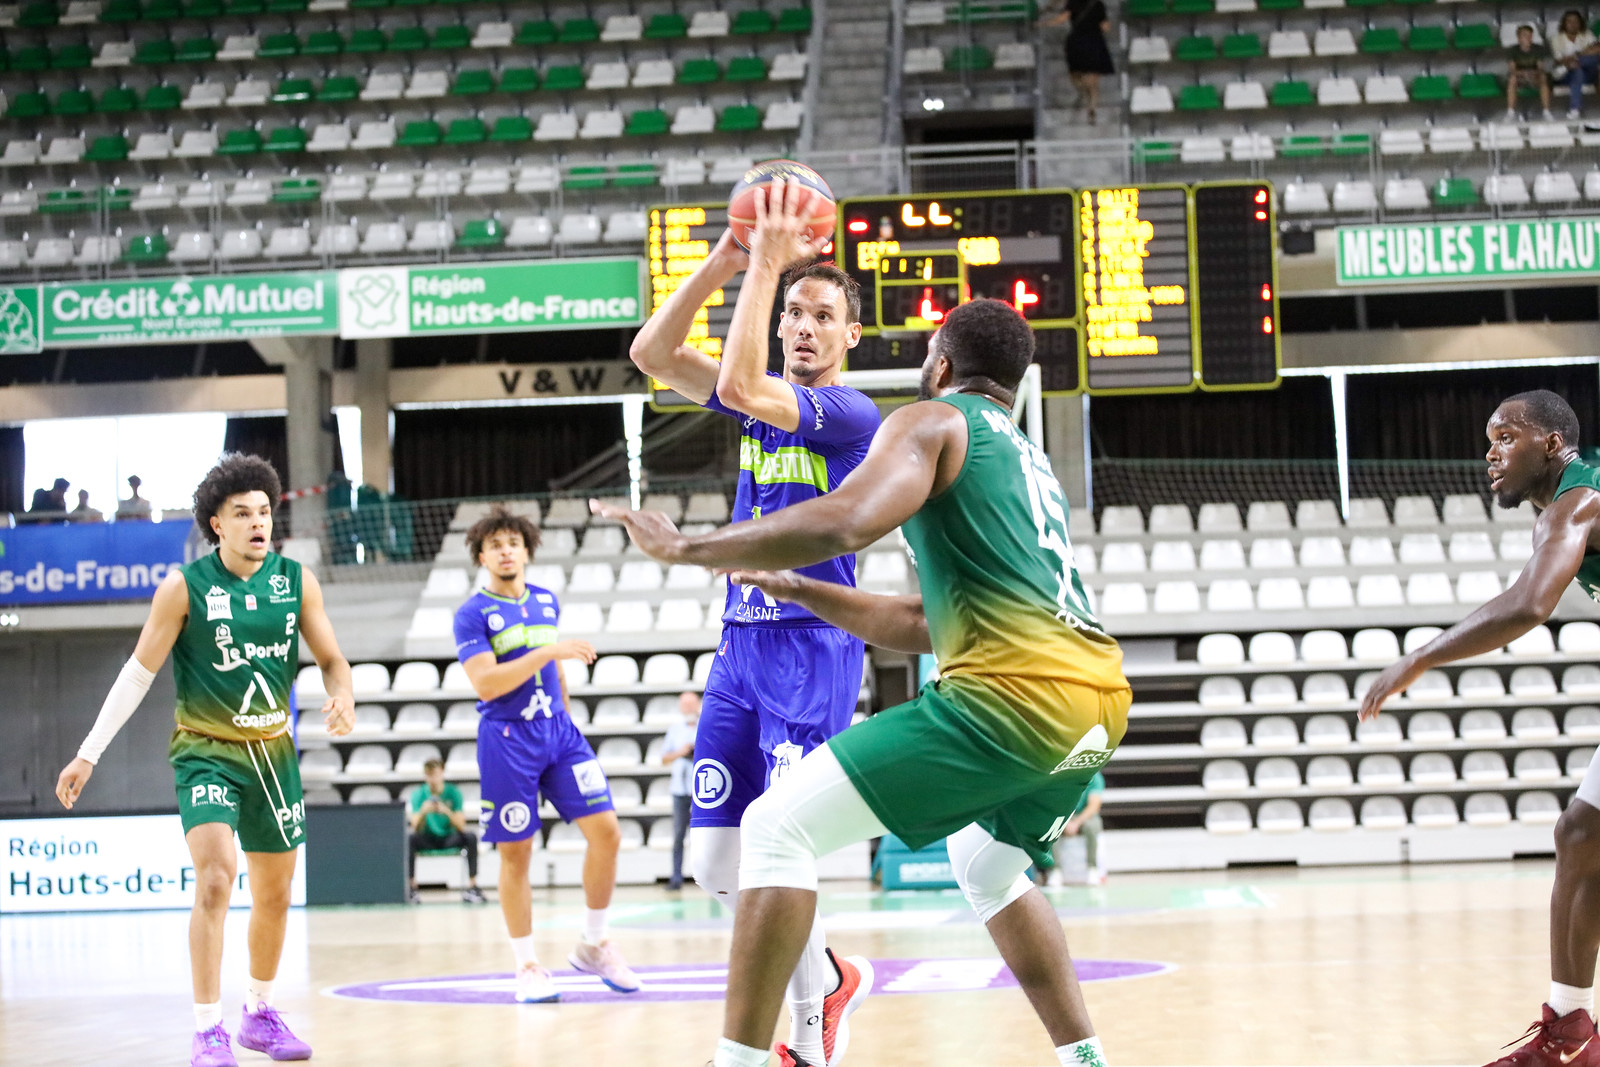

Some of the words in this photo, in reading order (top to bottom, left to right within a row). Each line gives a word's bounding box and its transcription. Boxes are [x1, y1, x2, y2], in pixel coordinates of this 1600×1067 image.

[1343, 225, 1475, 277] MEUBLES
[412, 274, 486, 299] Région
[52, 287, 158, 322] Crédit
[203, 279, 324, 315] Mutuel
[412, 295, 638, 327] Hauts-de-France
[499, 370, 522, 394] V
[532, 368, 559, 393] &
[569, 366, 605, 392] W
[210, 603, 228, 612] ibis
[736, 602, 781, 621] L'AISNE
[285, 612, 296, 635] 2
[232, 709, 286, 728] COGEDIM
[9, 835, 98, 861] Région
